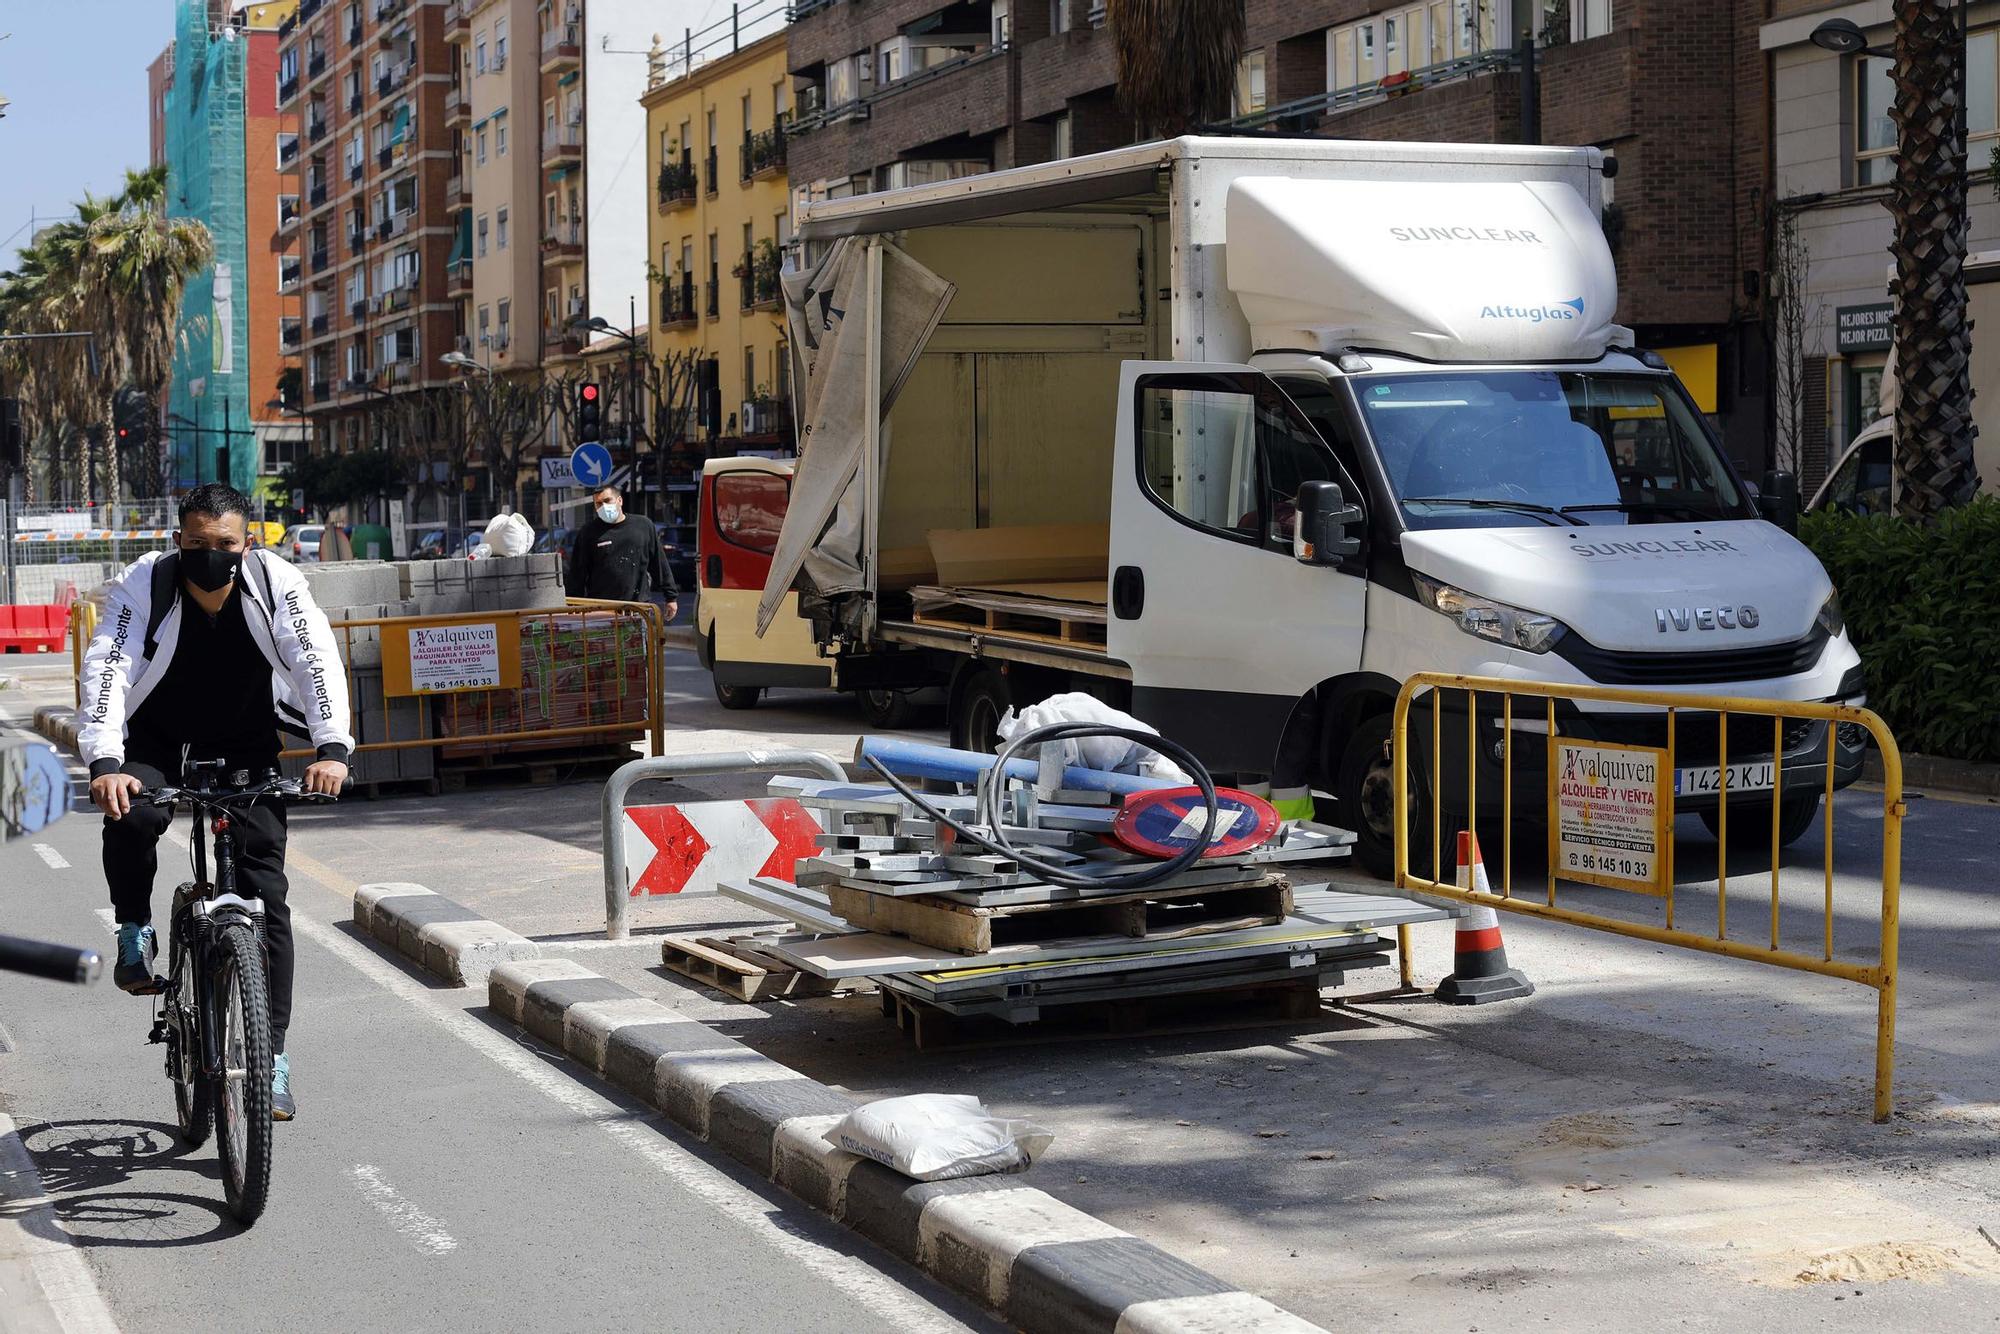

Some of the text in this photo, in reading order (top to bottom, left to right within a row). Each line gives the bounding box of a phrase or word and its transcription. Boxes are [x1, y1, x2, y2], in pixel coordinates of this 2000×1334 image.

[1389, 227, 1542, 243] SUNCLEAR
[1480, 305, 1573, 322] Altuglas
[1840, 312, 1874, 327] MEJORES
[1840, 328, 1890, 344] MEJOR PIZZA.
[1570, 540, 1739, 557] SUNCLEAR
[1655, 605, 1760, 632] IVECO
[413, 652, 457, 660] MAQUINARIA
[465, 649, 496, 657] EQUIPOS
[417, 645, 453, 654] ALQUILER
[434, 681, 446, 689] 96
[448, 680, 465, 688] 145
[481, 677, 492, 686] 33
[92, 666, 117, 724] Kennedy
[310, 667, 332, 720] America
[1689, 768, 1735, 791] 1422
[1742, 765, 1775, 788] KJL
[1561, 783, 1655, 805] ALQUILER Y VENTA
[1564, 834, 1590, 844] SERVICIO
[1616, 840, 1652, 852] POST-VENTA
[1582, 854, 1647, 877] 96 145 10 33
